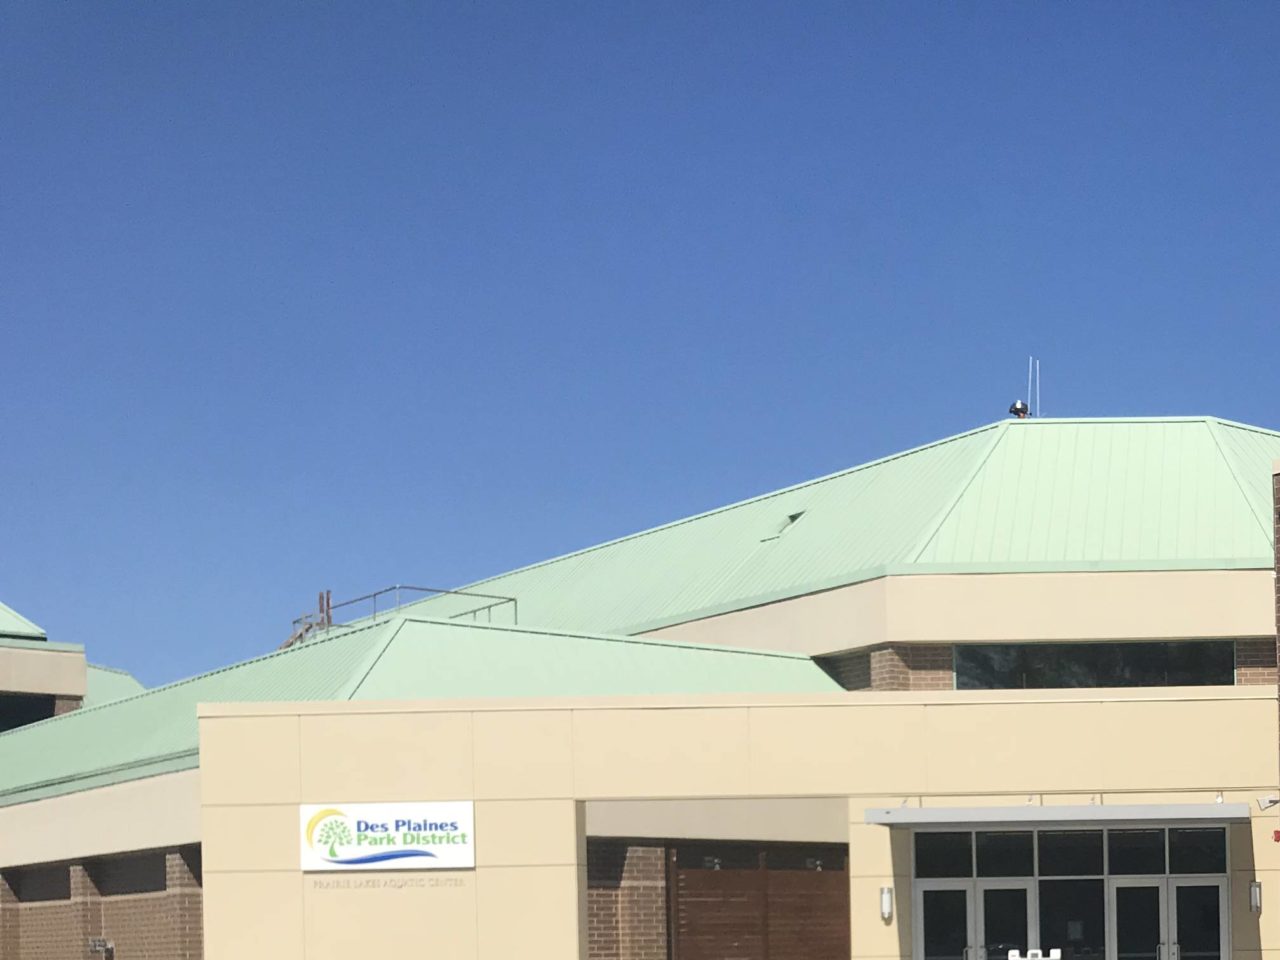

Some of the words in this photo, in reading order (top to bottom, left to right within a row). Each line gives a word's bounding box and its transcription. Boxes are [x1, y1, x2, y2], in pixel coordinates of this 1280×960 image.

[356, 820, 389, 833] Des
[394, 819, 459, 832] Plaines
[356, 832, 397, 846] Park
[402, 832, 468, 845] District
